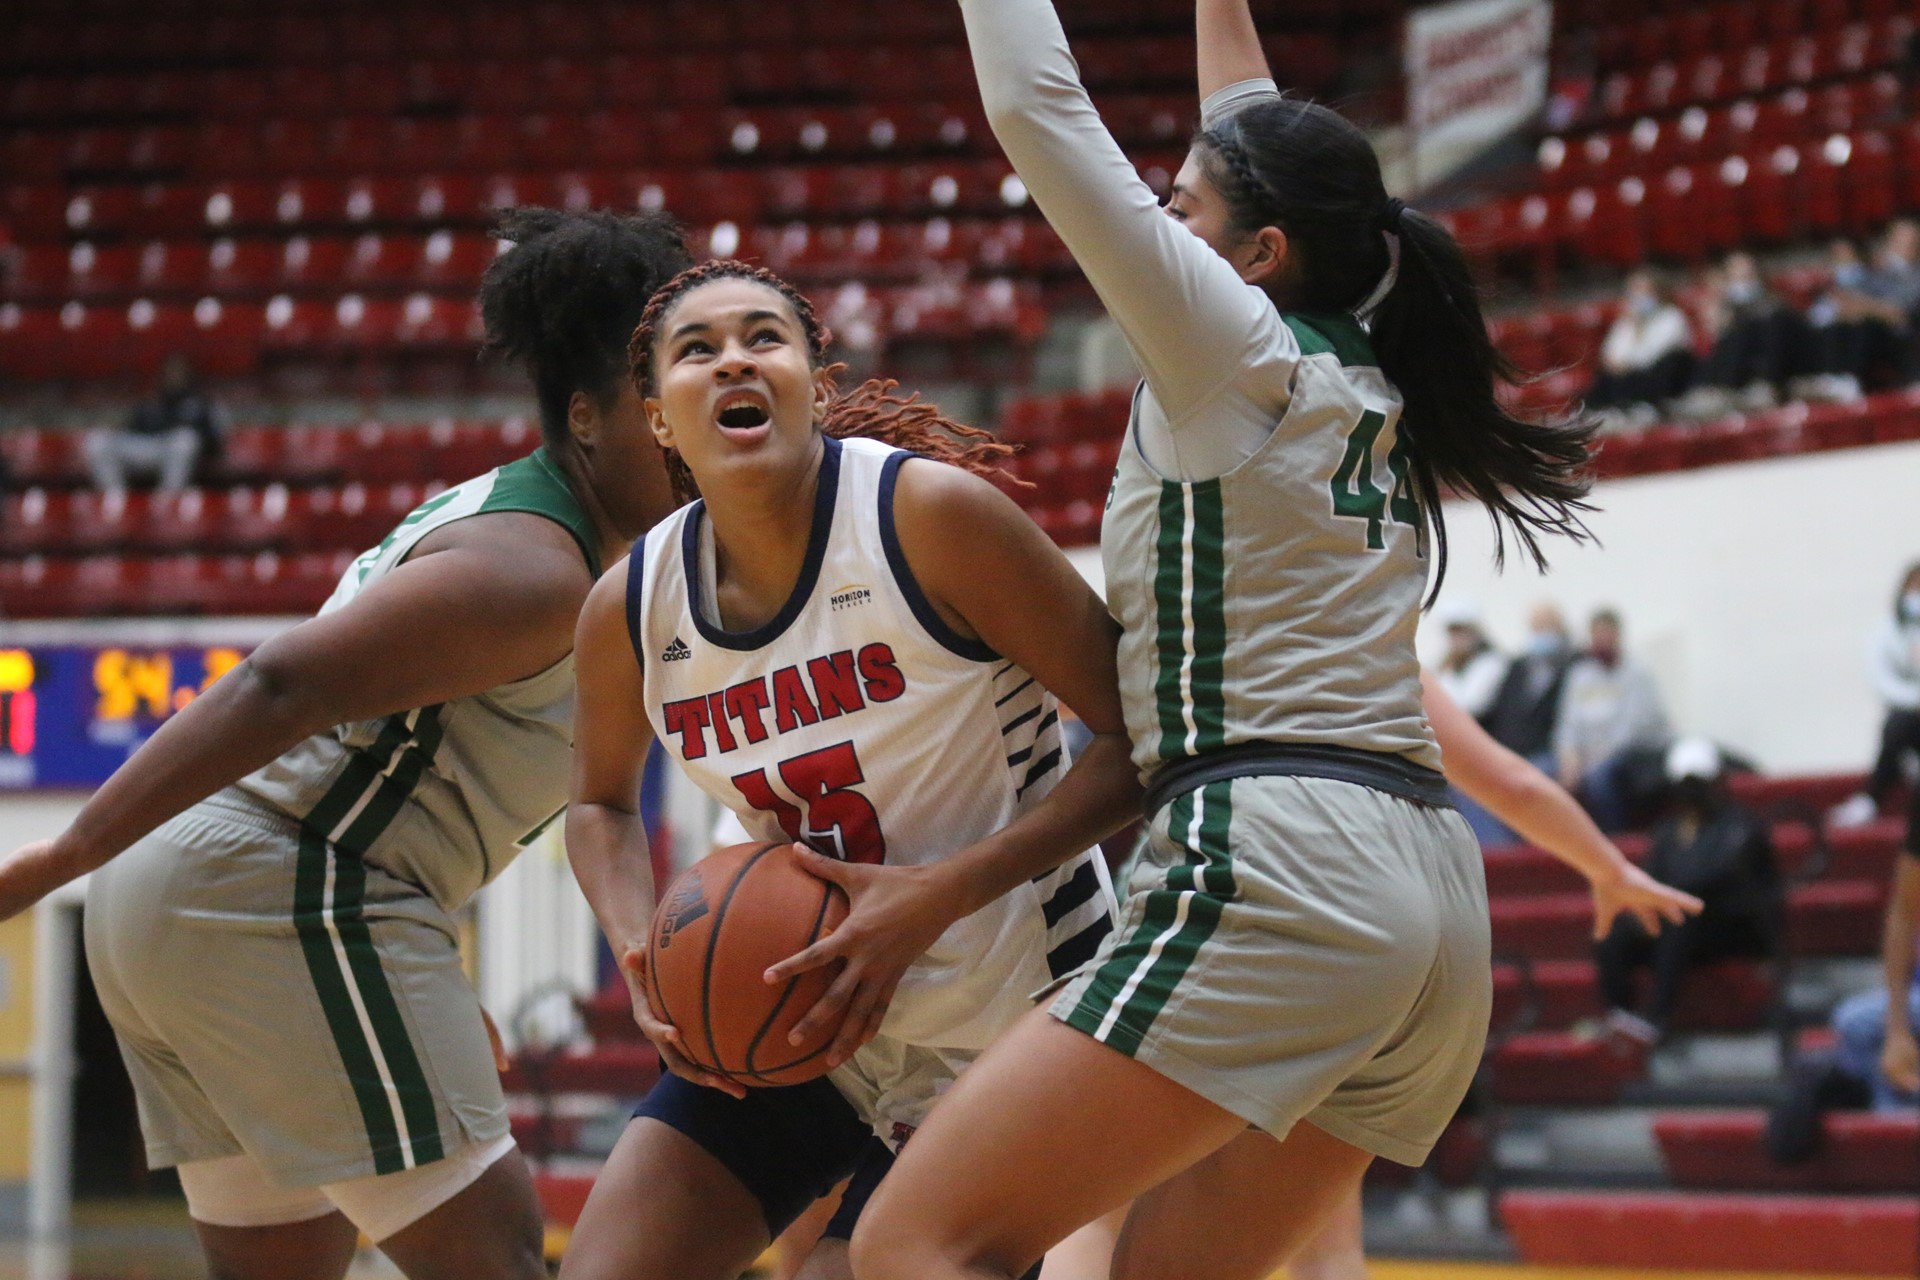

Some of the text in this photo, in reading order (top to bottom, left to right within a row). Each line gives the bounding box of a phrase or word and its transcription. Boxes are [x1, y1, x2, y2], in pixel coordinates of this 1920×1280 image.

[1330, 406, 1424, 560] 44
[830, 589, 871, 606] HORIZON
[832, 598, 872, 612] LEAGUE
[662, 649, 692, 662] adidas
[662, 642, 906, 761] TITANS
[731, 739, 886, 865] 15
